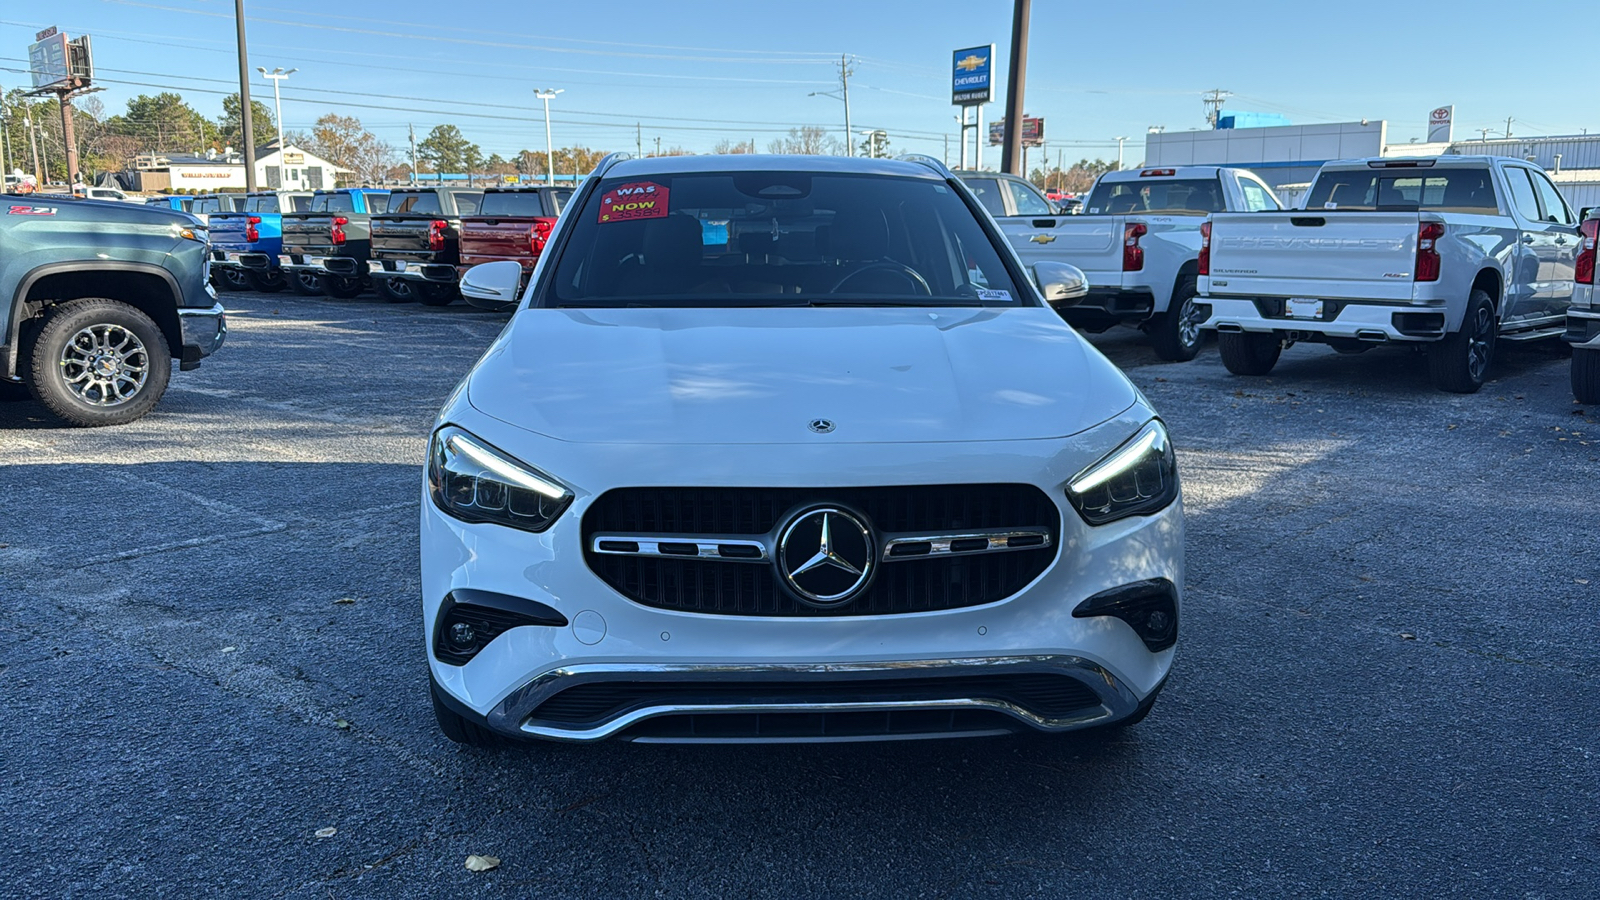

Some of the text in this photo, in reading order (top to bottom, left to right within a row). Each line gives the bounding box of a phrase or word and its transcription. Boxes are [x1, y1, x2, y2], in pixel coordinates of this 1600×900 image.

[954, 75, 987, 85] CHEVROLET
[954, 91, 988, 101] MILTON RUBEN
[617, 186, 655, 195] WAS
[7, 205, 58, 216] Z71
[612, 201, 655, 212] NOW
[1221, 237, 1403, 252] CHEVROLET
